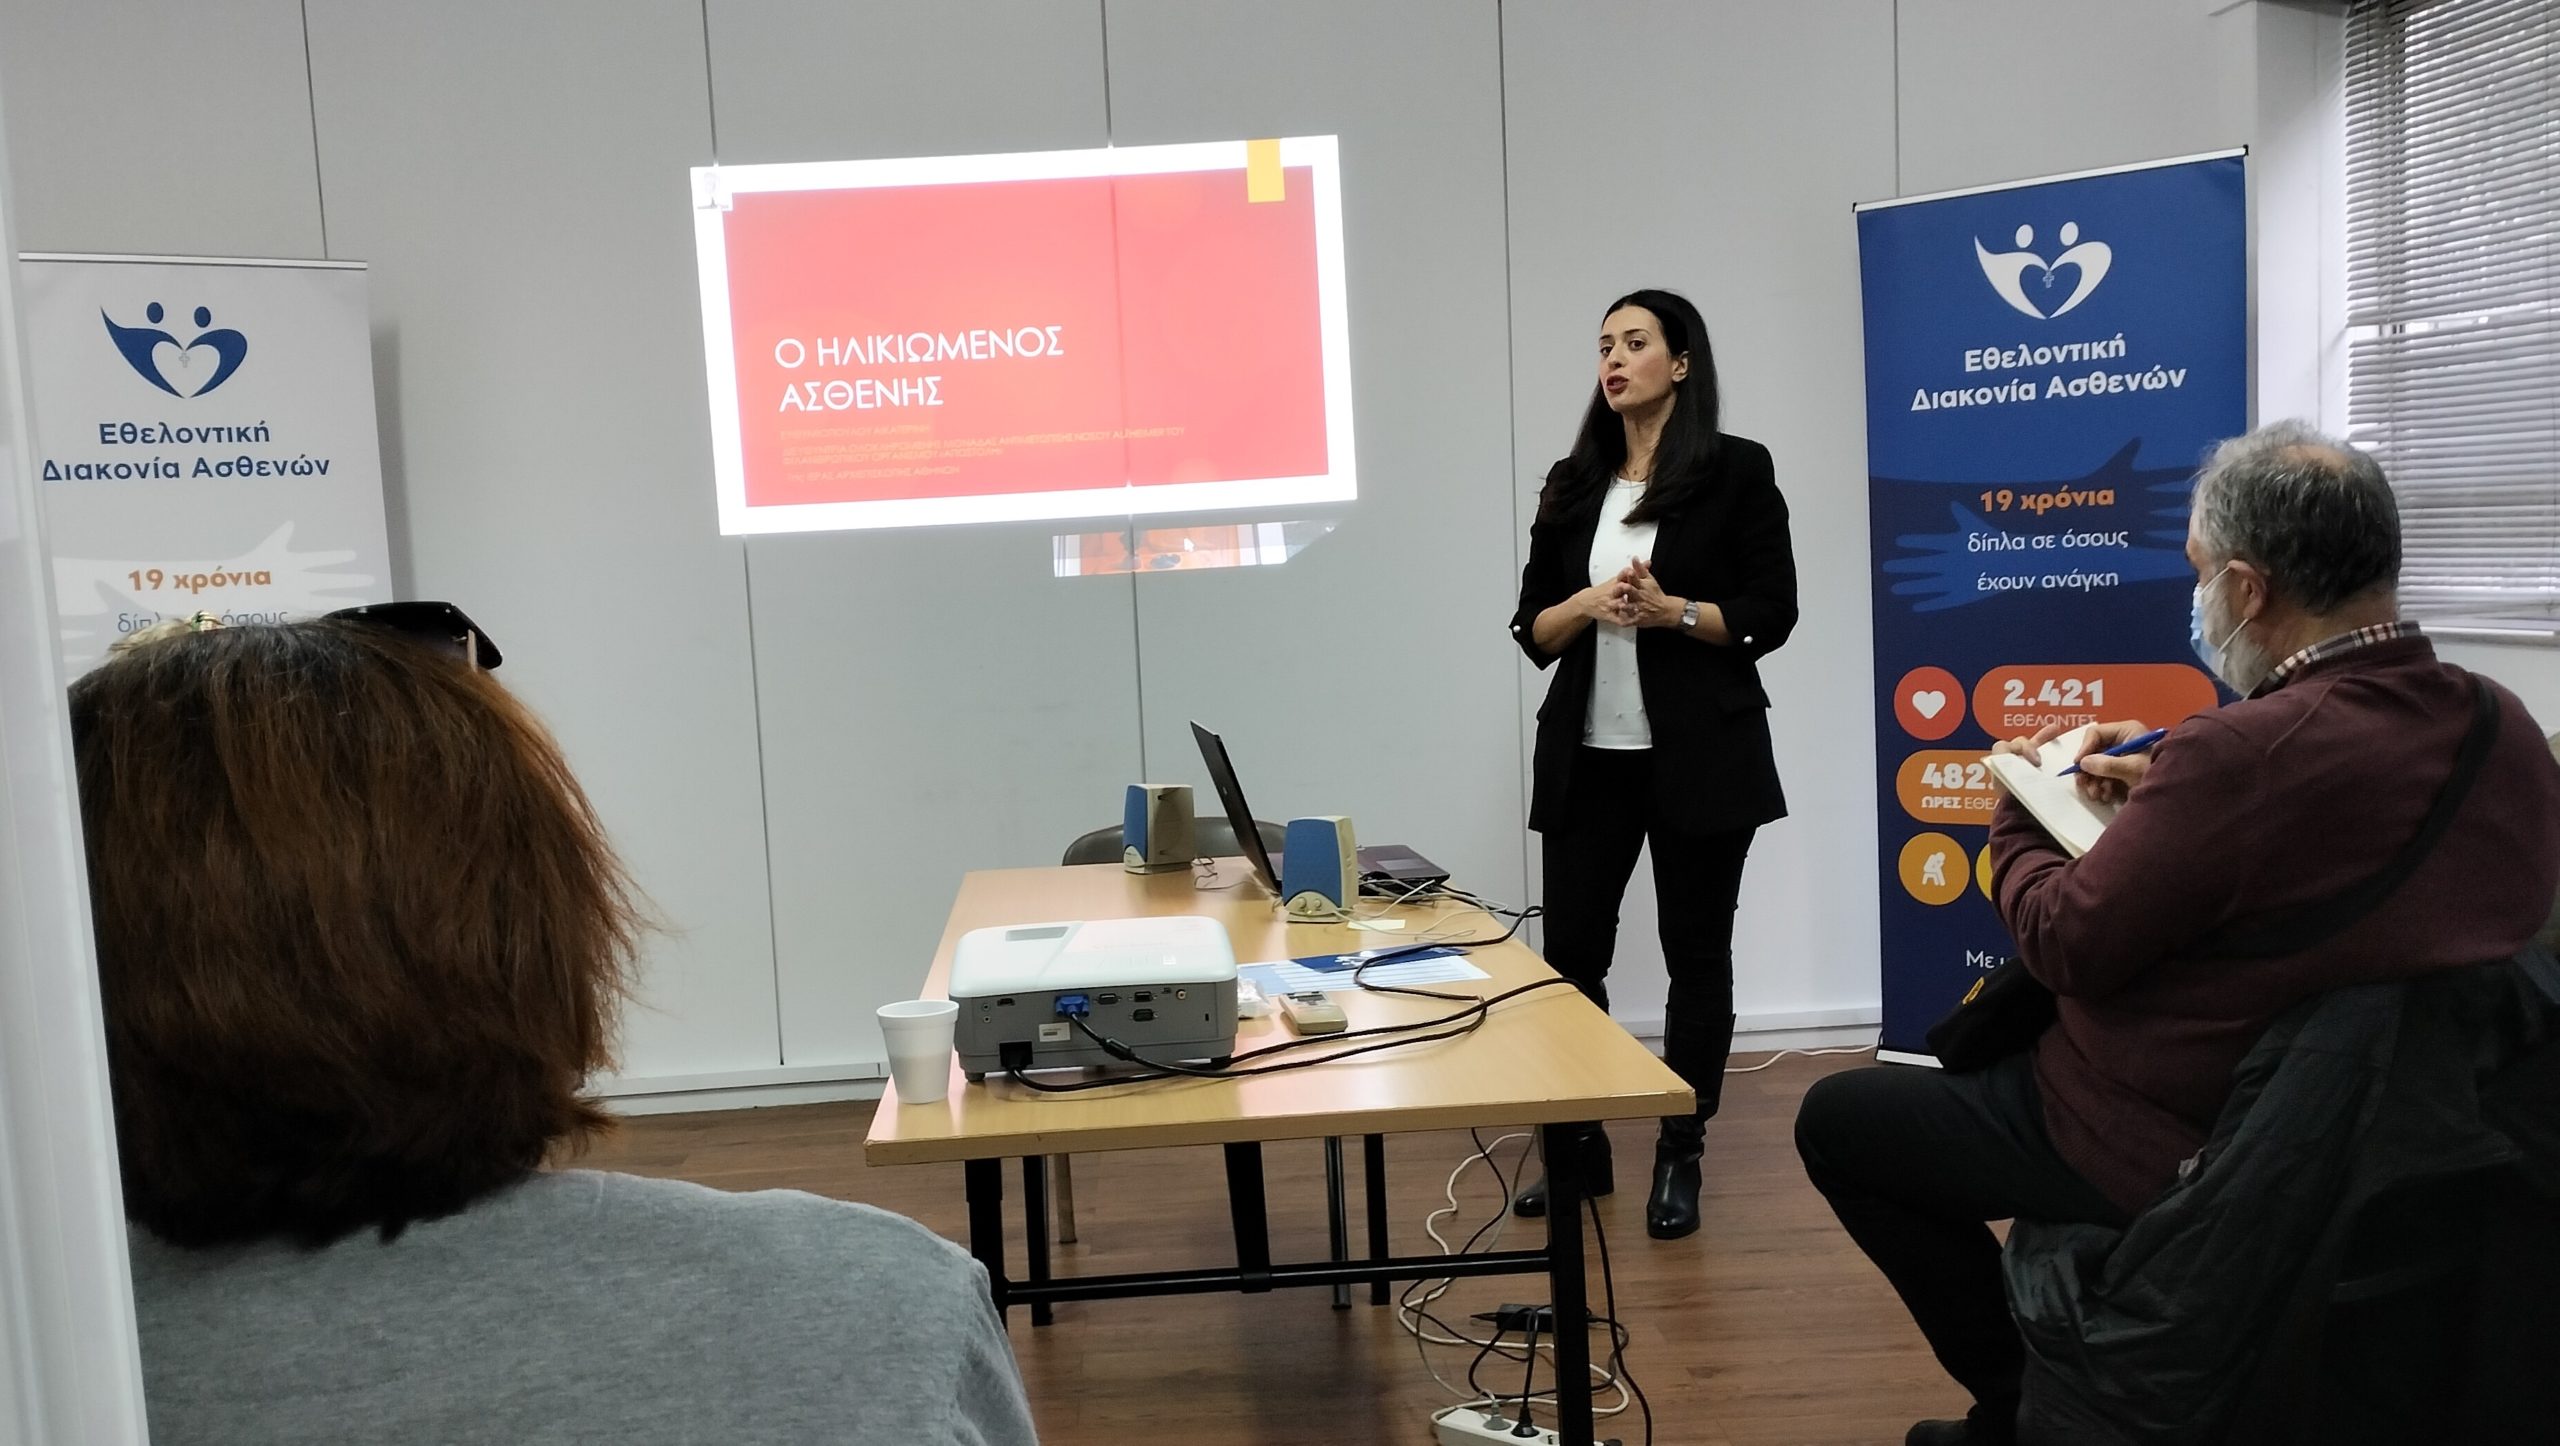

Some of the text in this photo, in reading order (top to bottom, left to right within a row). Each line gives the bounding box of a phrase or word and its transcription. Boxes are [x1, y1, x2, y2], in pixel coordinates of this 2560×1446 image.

[775, 325, 1065, 370] Ο ΗΛΙΚΙΩΜΕΝΟΣ
[1964, 333, 2126, 372] Εθελοντική
[779, 375, 944, 413] ΑΣΘΕΝΗΣ
[1911, 364, 2186, 411] Διακονία Ασθενών
[99, 420, 270, 445] Εθελοντική
[42, 454, 330, 481] Διακονία Ασθενών
[1980, 485, 2115, 515] 19 χρόνια
[1968, 528, 2129, 552] δίπλα σε όσους
[128, 566, 272, 594] 19 χρόνια
[1977, 568, 2119, 593] έχουν ανάγκη
[2003, 678, 2104, 707] 2.421
[1921, 796, 1962, 809] ΩΡΕΣ
[1966, 949, 1995, 969] Με
